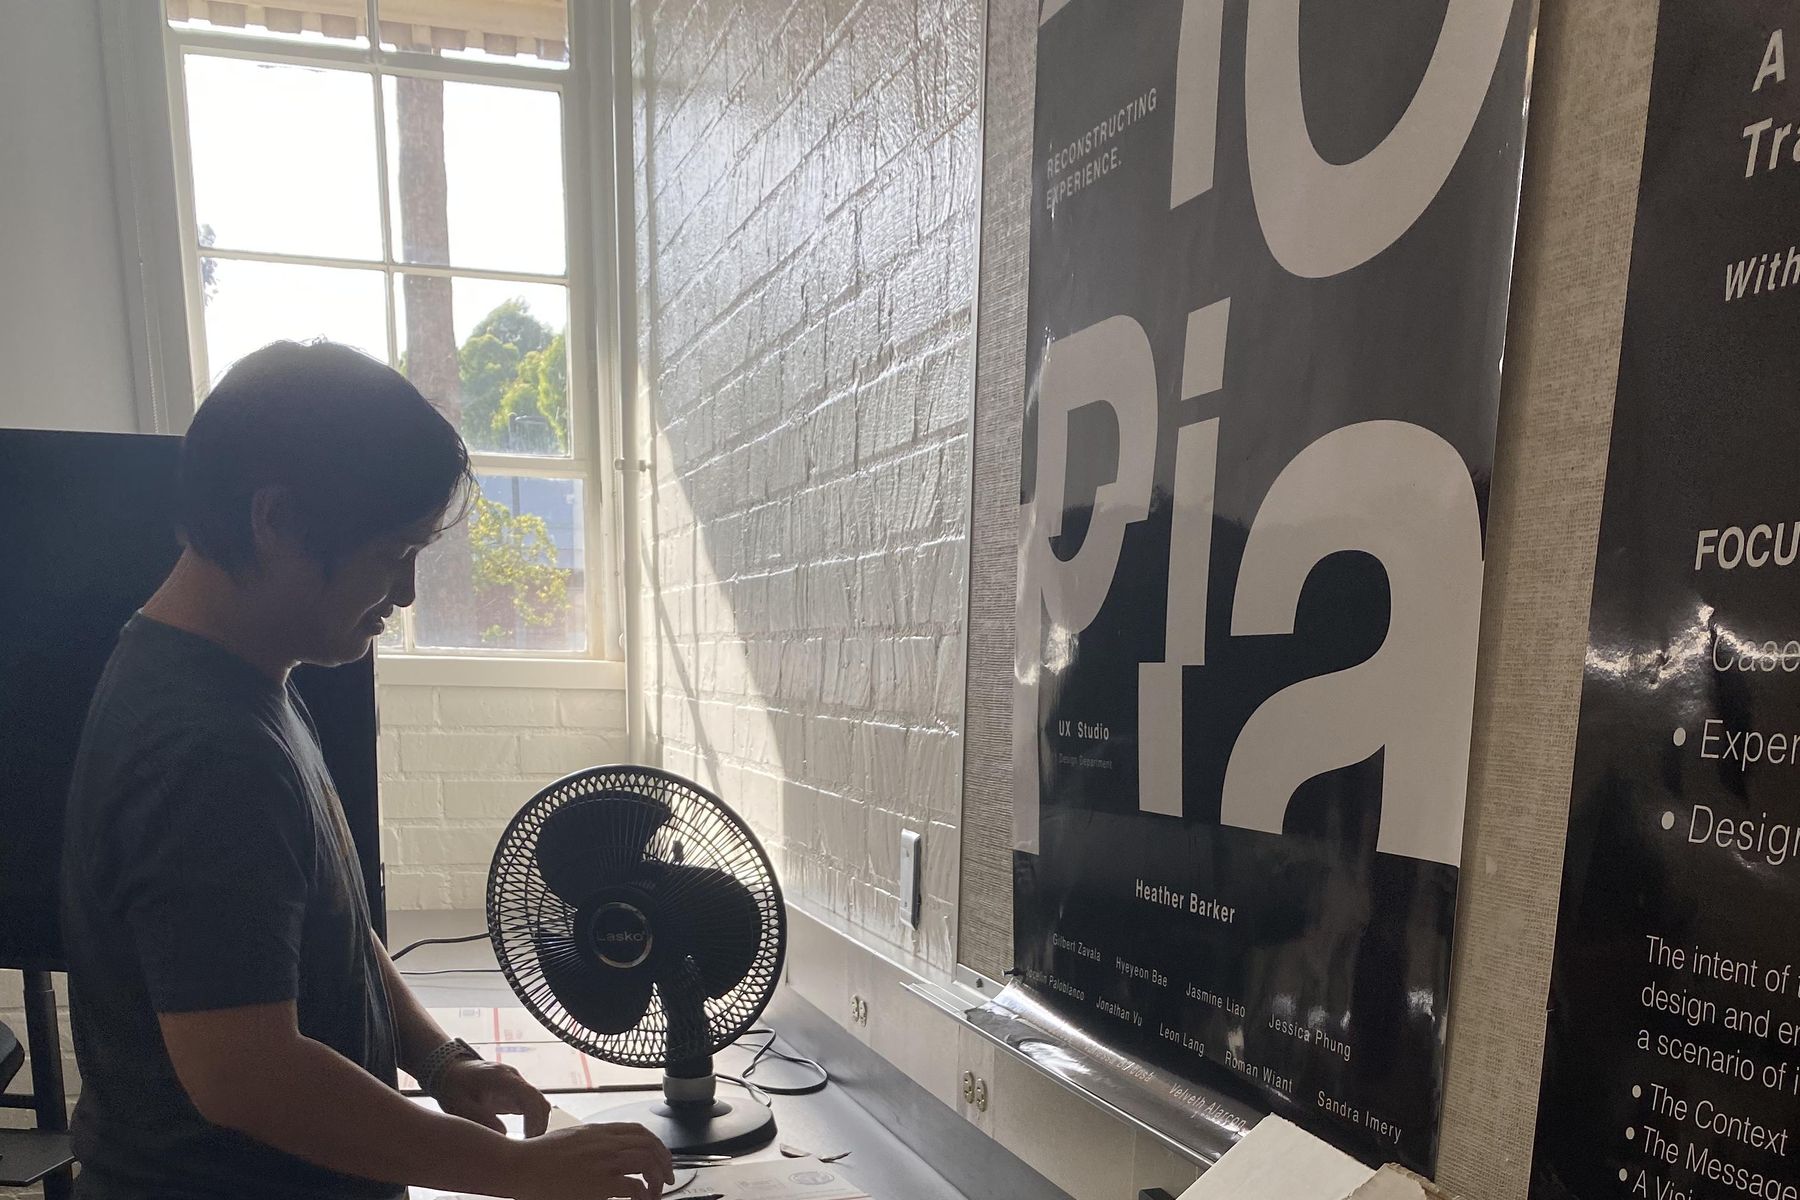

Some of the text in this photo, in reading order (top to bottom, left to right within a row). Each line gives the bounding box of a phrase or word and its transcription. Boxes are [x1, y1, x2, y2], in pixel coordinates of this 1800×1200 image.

[1751, 28, 1787, 93] A
[1046, 87, 1159, 179] RECONSTRUCTING
[1695, 520, 1800, 571] FOCU
[1058, 719, 1110, 741] UX Studio
[1700, 718, 1800, 773] Exper
[1135, 878, 1236, 924] Heather Barker
[1077, 941, 1102, 962] Zavala
[1115, 956, 1169, 988] Hyeyeon Bae
[1646, 935, 1686, 970] The
[1692, 945, 1758, 988] intent
[1764, 964, 1791, 994] of
[1095, 995, 1143, 1027] Jonathan Vu
[1185, 981, 1246, 1018] Jasmine Liao
[1641, 981, 1716, 1026] design
[1724, 1009, 1770, 1038] and
[1158, 1022, 1205, 1057] Leon Lang
[1267, 1012, 1352, 1062] Jessica Phung
[1637, 1029, 1650, 1051] a
[1657, 1034, 1755, 1081] scenario
[1762, 1062, 1787, 1091] of
[1223, 1050, 1294, 1094] Roman Wiant
[1168, 1082, 1206, 1109] Velveth
[1316, 1089, 1403, 1145] Sandra Imery
[1650, 1083, 1789, 1157] The Context
[1643, 1125, 1679, 1165] The
[1632, 1169, 1647, 1199] A
